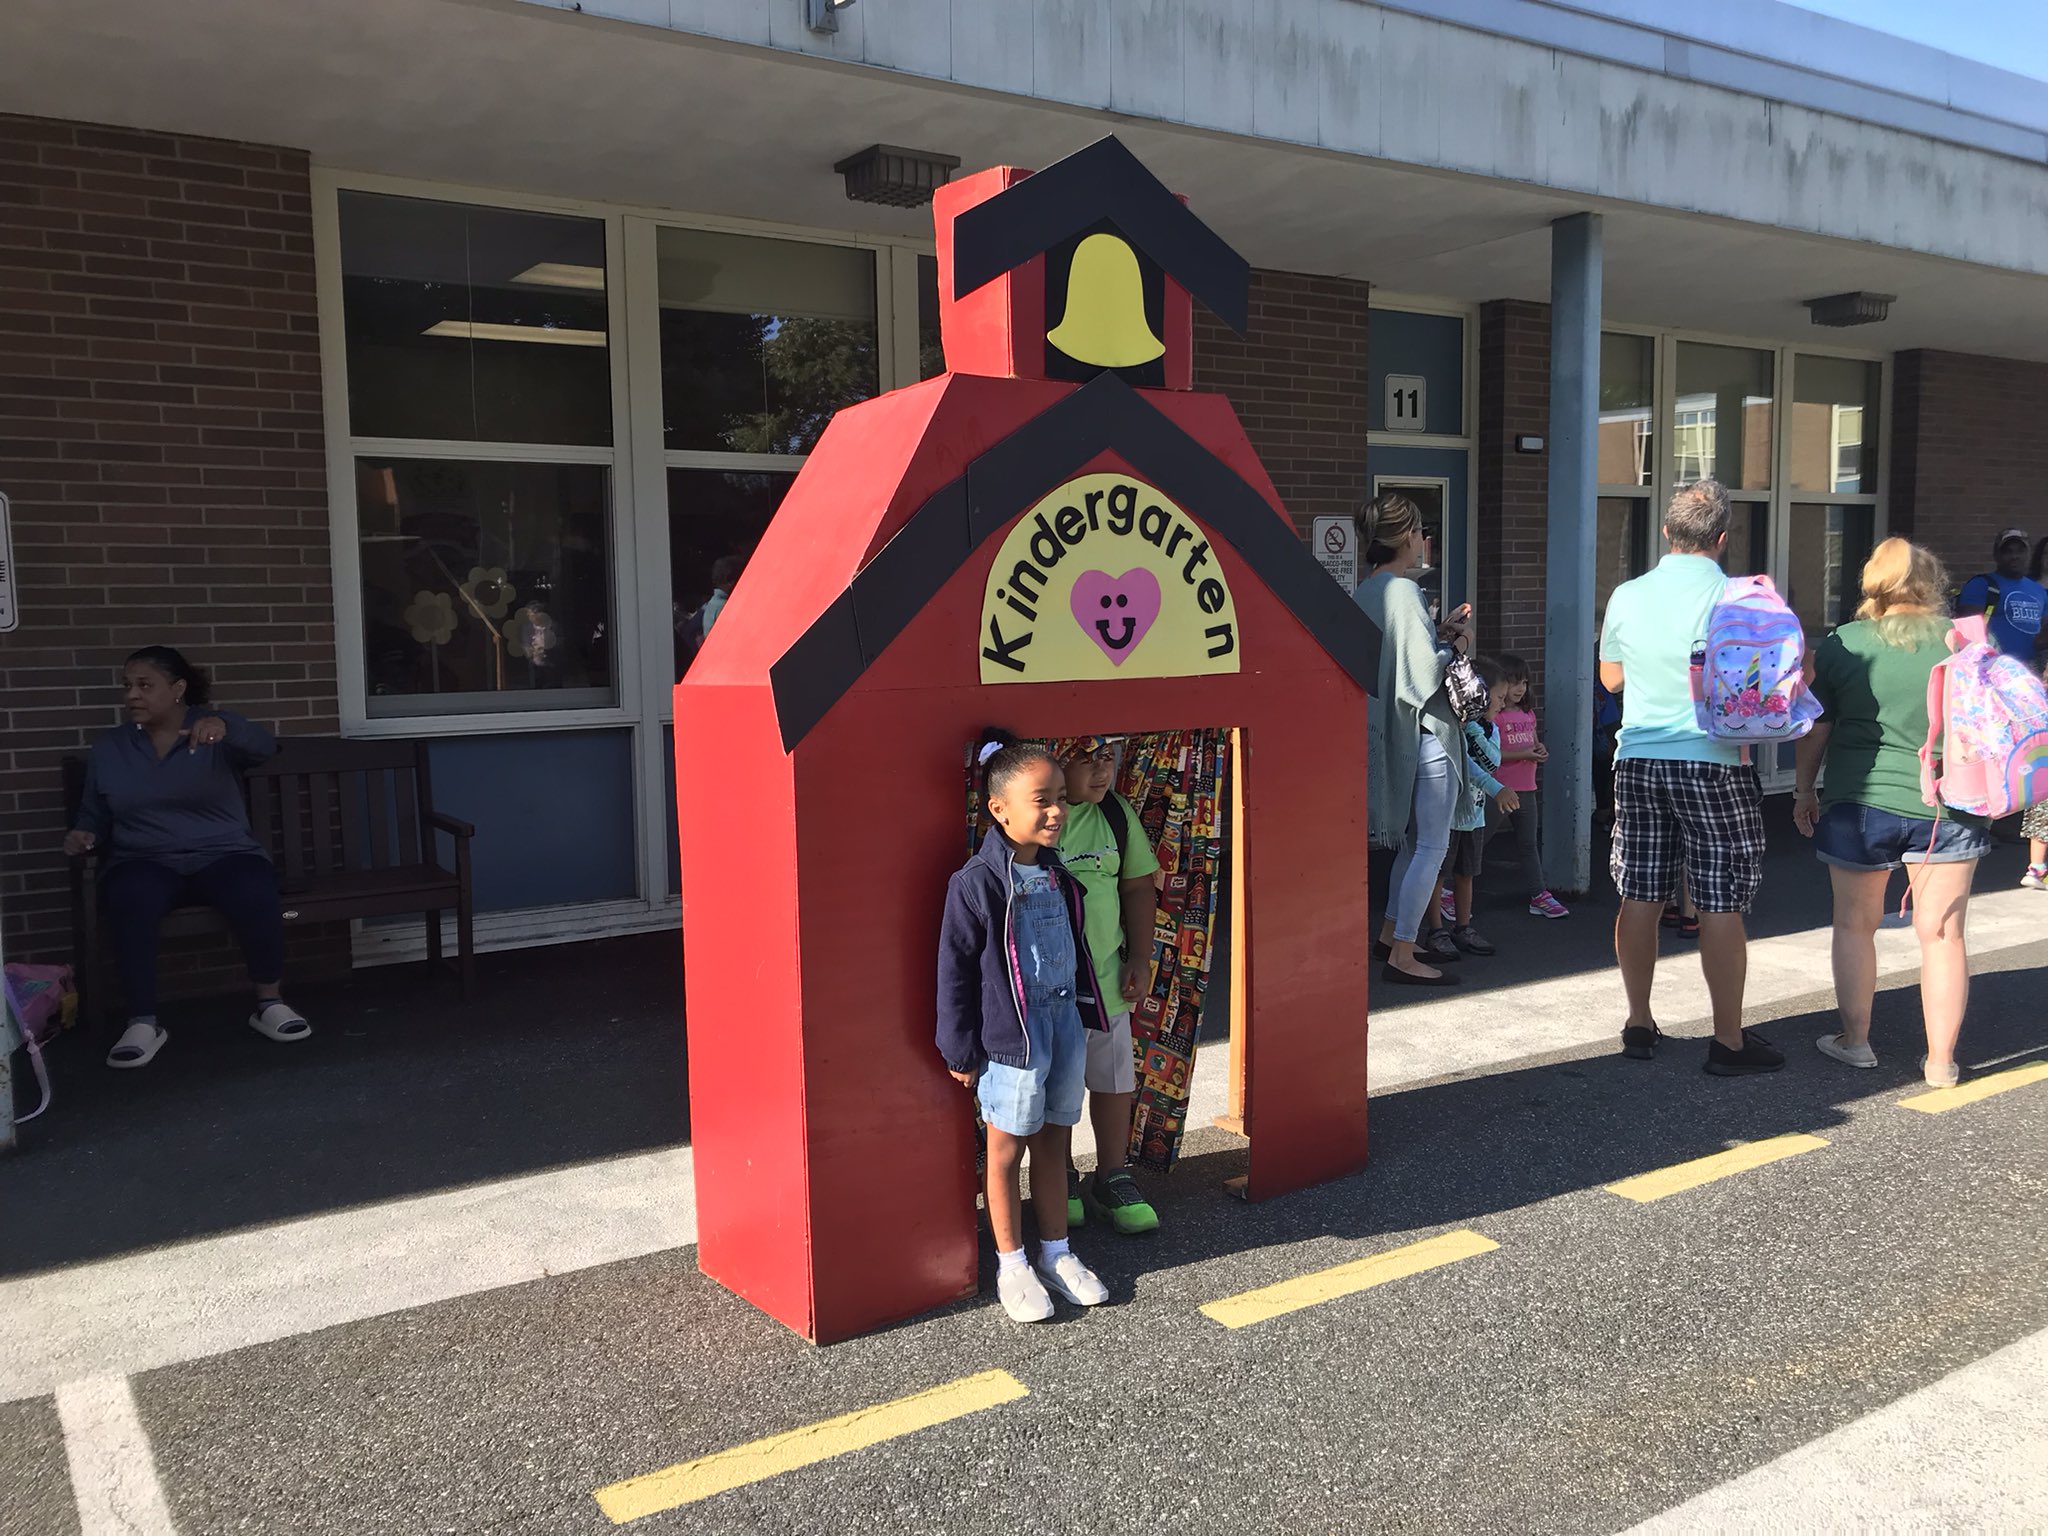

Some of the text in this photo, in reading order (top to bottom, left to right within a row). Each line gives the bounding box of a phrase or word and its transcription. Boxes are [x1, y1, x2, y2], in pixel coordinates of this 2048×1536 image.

[1393, 389, 1417, 418] 11
[982, 484, 1235, 673] Kindergarten
[2012, 607, 2041, 620] BLUE
[1507, 732, 1534, 744] BOWS
